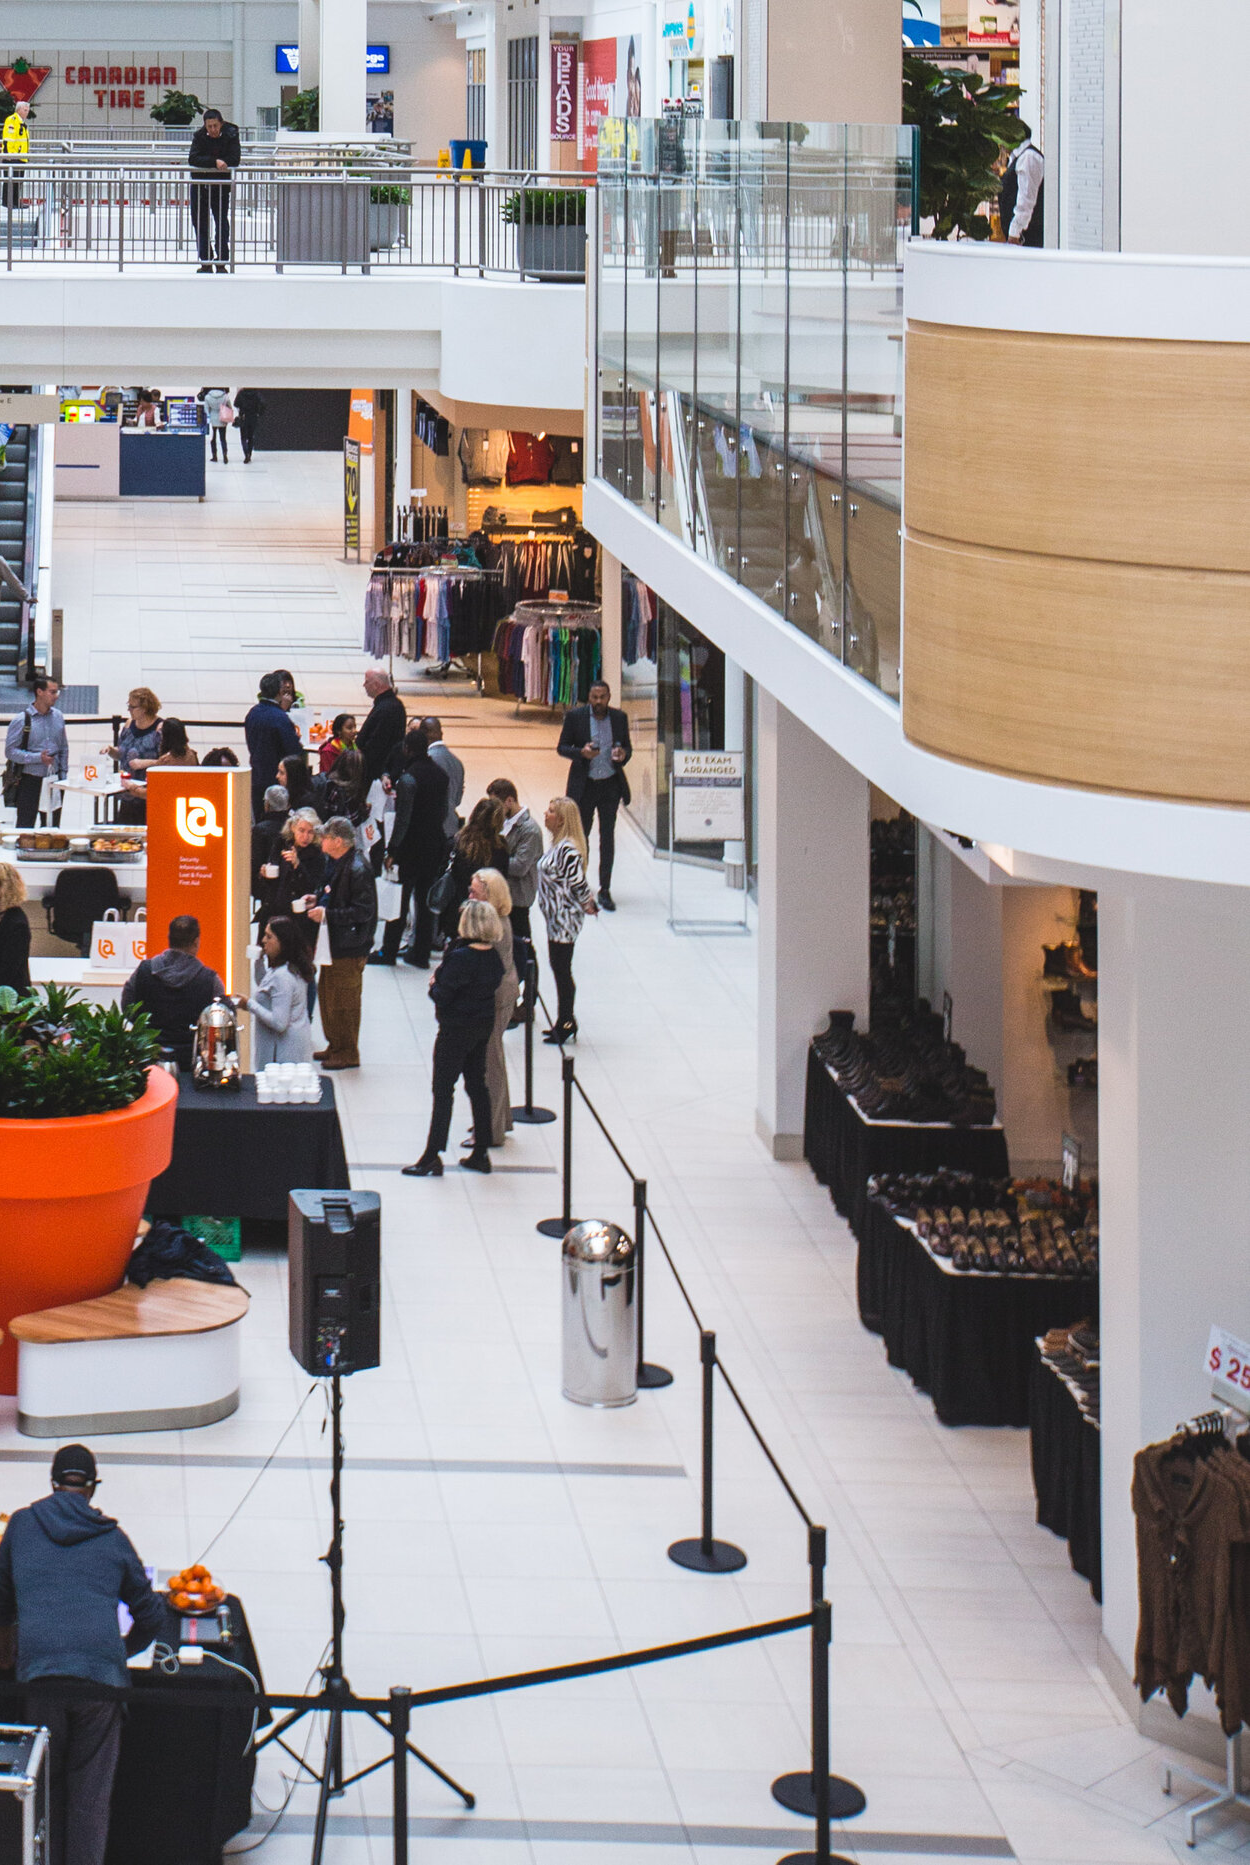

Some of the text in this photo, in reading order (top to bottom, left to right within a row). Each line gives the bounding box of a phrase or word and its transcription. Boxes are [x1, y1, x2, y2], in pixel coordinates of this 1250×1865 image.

[553, 45, 575, 53] YOUR
[65, 66, 177, 86] CANADIAN
[94, 89, 146, 109] TIRE
[555, 52, 573, 134] BEADS
[684, 756, 732, 765] EYE EXAM
[683, 766, 737, 775] ARRANGED
